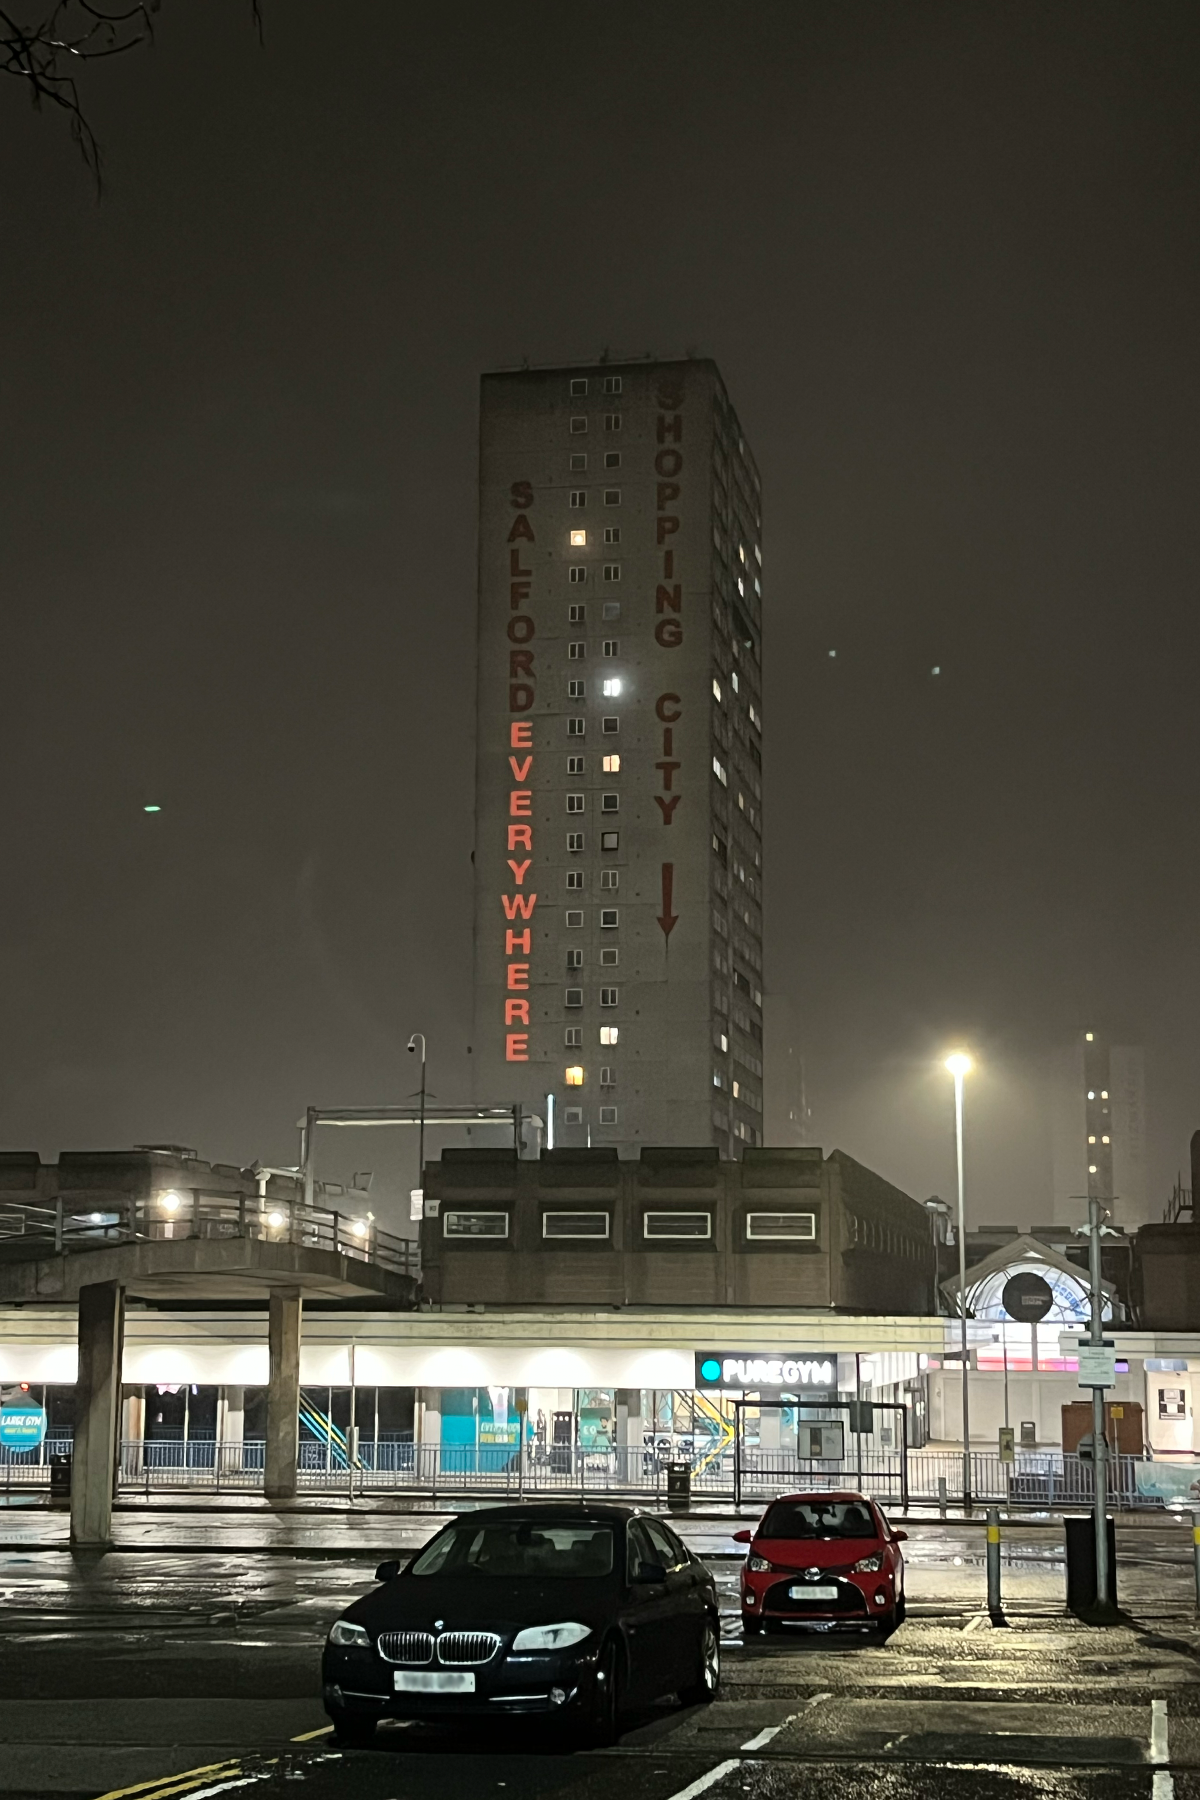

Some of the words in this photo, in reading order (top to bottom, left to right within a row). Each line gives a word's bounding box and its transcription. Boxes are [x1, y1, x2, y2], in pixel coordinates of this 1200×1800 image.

[507, 480, 536, 714] SALFORD
[654, 381, 683, 648] SHOPPING
[654, 692, 682, 826] CITY
[501, 721, 537, 1061] EVERYWHERE
[1, 1415, 25, 1426] LARGE
[25, 1416, 42, 1426] GYM
[722, 1359, 832, 1384] PUREGYM
